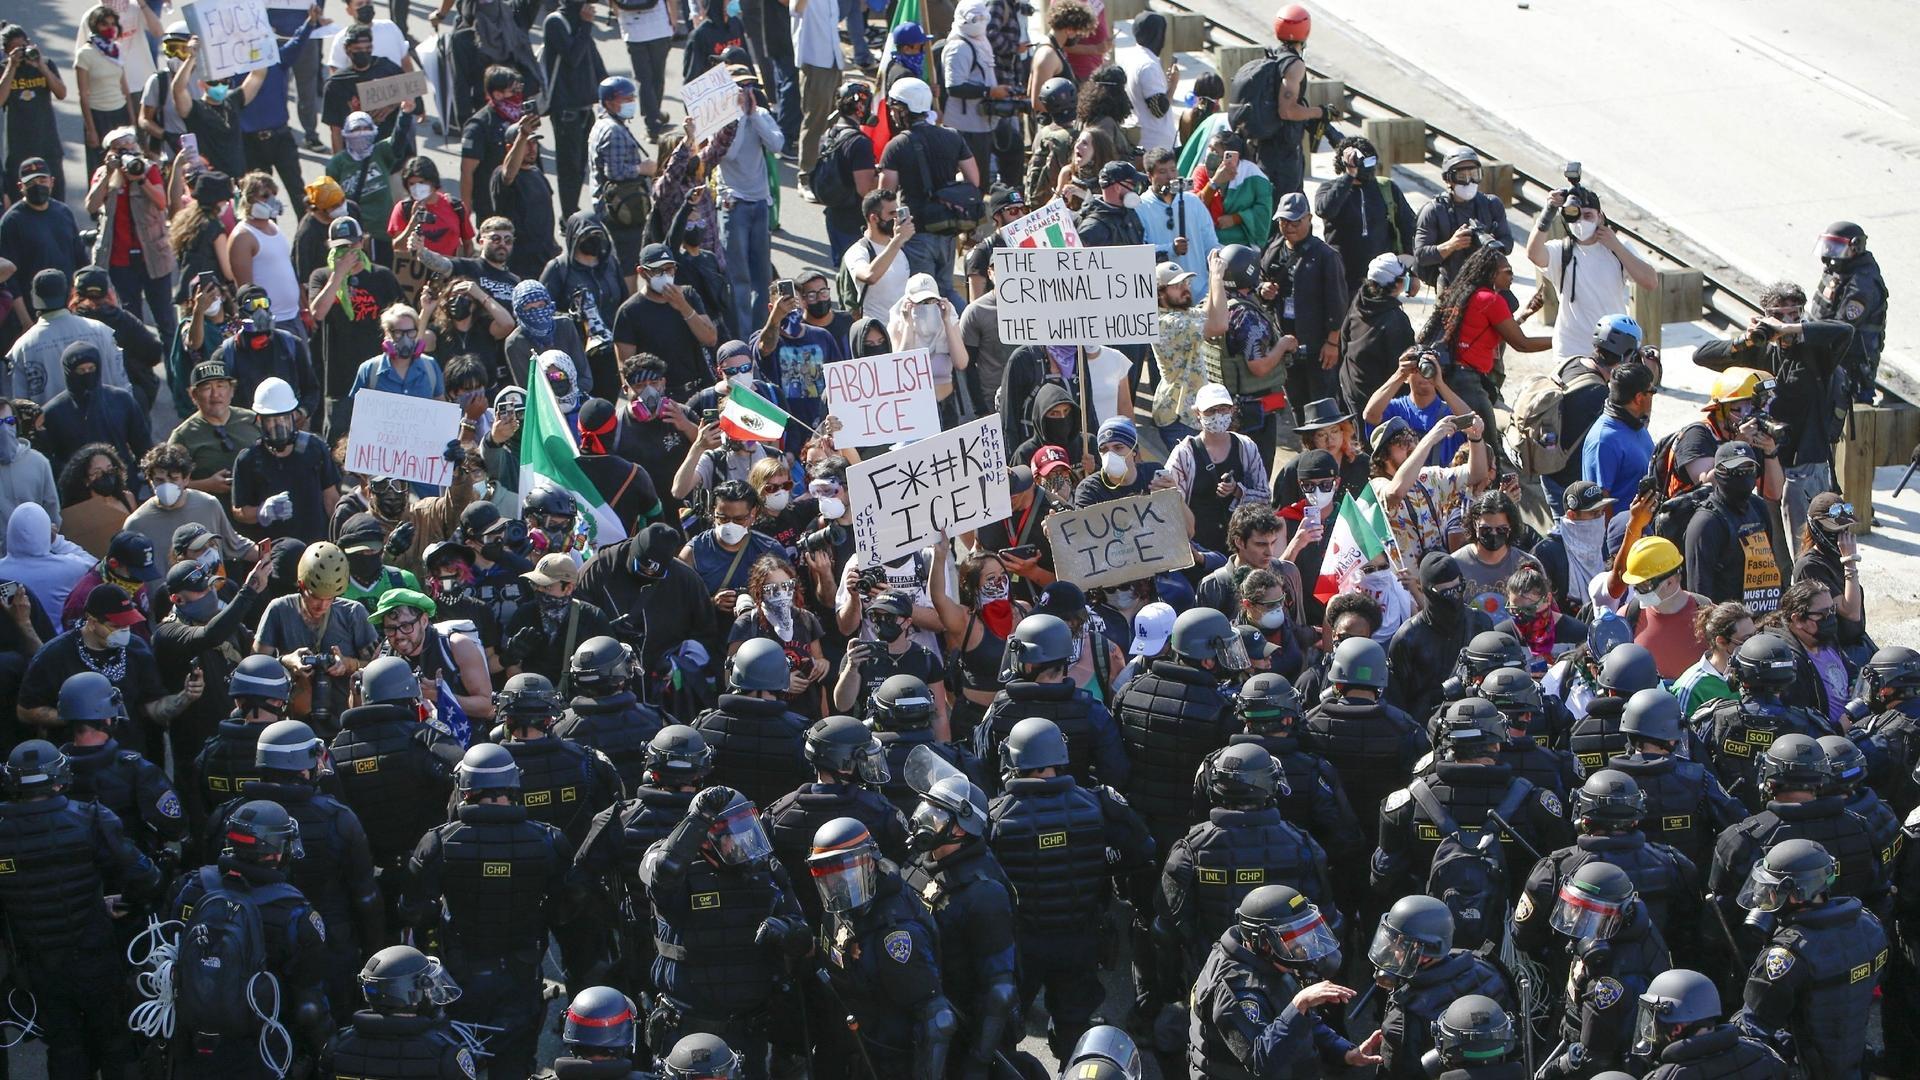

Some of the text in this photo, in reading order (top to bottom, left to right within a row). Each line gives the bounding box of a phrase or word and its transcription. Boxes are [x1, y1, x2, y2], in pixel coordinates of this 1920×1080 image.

[204, 1, 268, 38] FUCK
[1007, 203, 1061, 237] WE ARE ALL
[1024, 212, 1061, 237] DREAMERS
[996, 250, 1113, 273] THE REAL
[1000, 272, 1154, 304] CRIMINAL IS IN
[1002, 312, 1158, 341] THE WHITE HOUSE
[829, 354, 932, 404] ABOLISH
[859, 398, 915, 437] ICE
[980, 424, 996, 483] BROWN
[991, 431, 1006, 485] PRIDE
[354, 444, 449, 484] INHUMANITY
[1060, 502, 1165, 545] FUCK
[1746, 572, 1779, 585] Regime
[1744, 588, 1780, 600] MUST GO
[1746, 599, 1777, 612] NOW!!!
[1138, 623, 1147, 637] LA
[1750, 732, 1770, 743] SOU
[1728, 743, 1748, 753] CHP
[358, 761, 376, 772] CHP
[1581, 755, 1599, 765] SOU
[527, 793, 548, 804] CHP
[1425, 828, 1440, 838] INL
[1042, 836, 1063, 846] CHP
[486, 865, 508, 875] CHP
[1205, 872, 1261, 881] INL CHP
[1853, 966, 1868, 979] CHP
